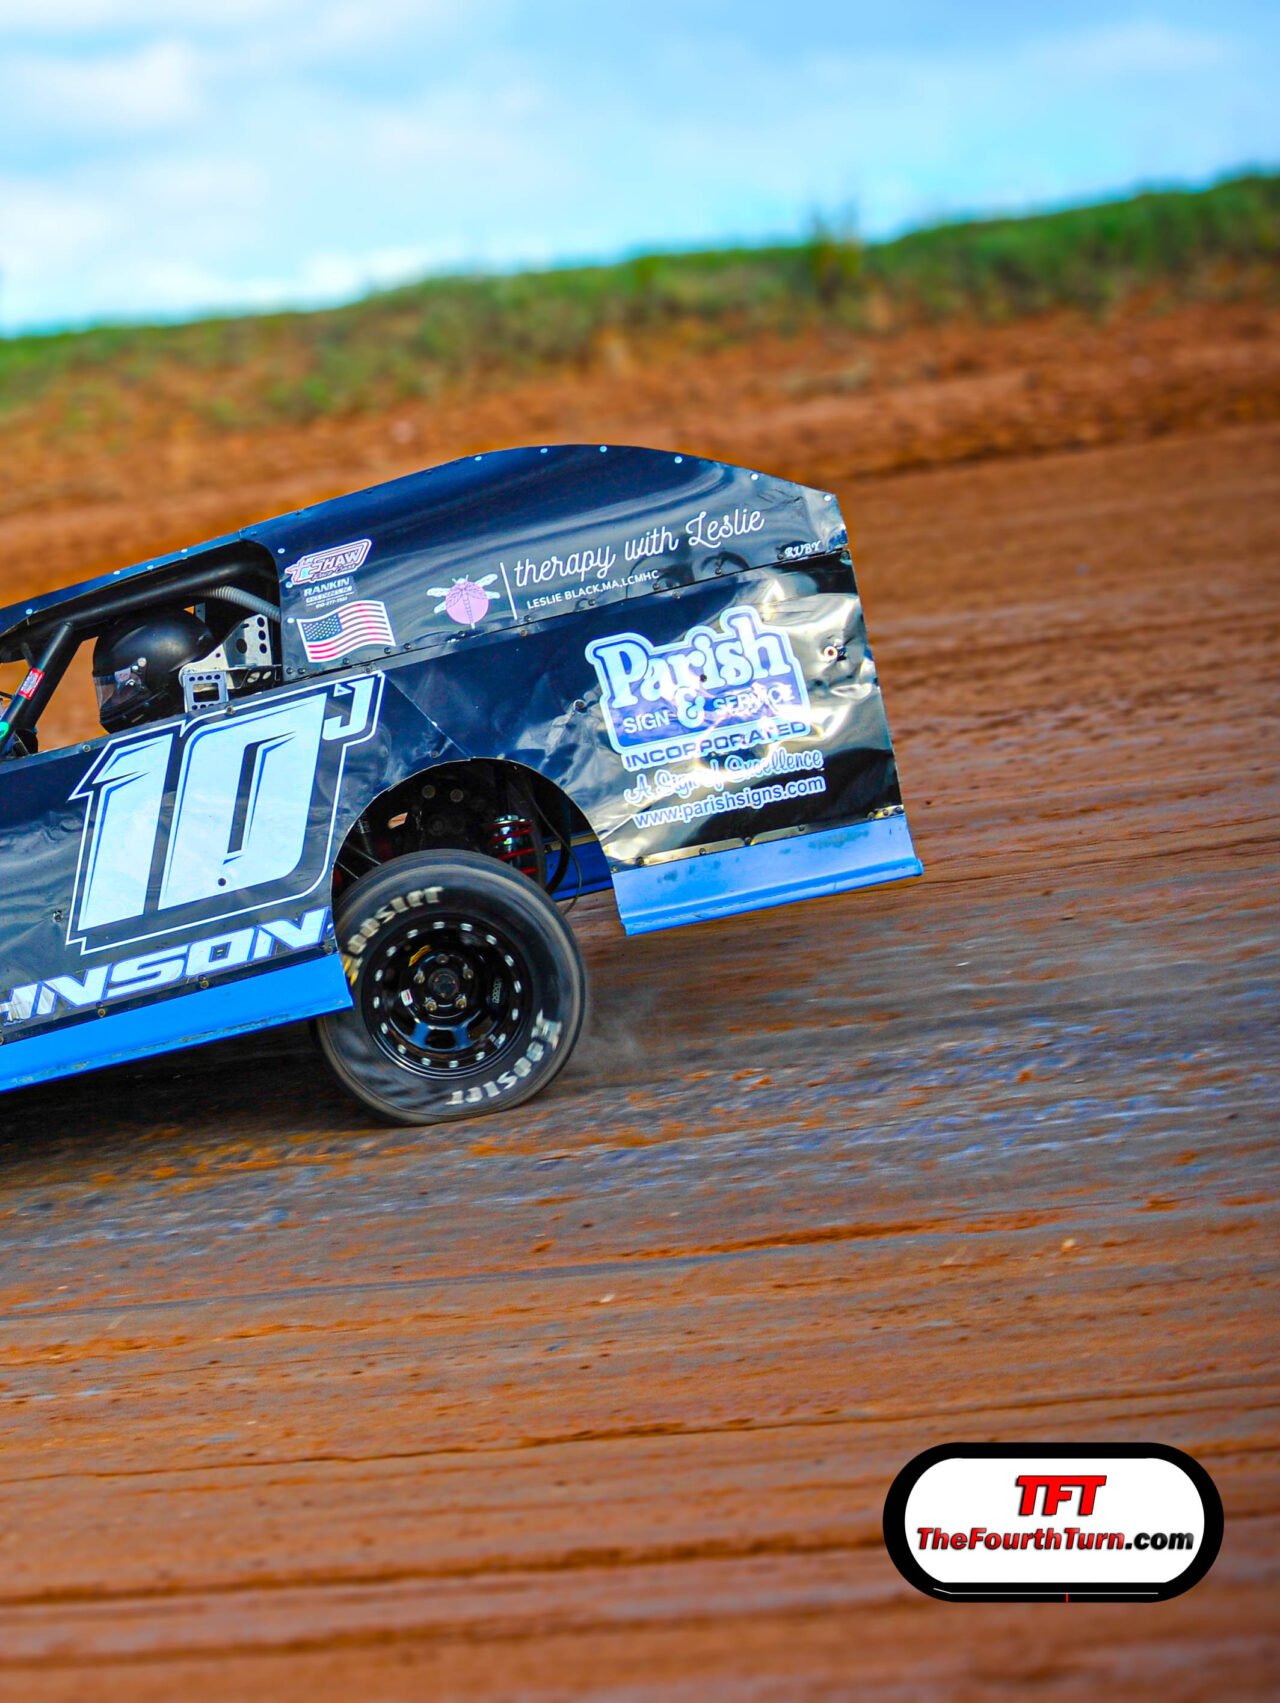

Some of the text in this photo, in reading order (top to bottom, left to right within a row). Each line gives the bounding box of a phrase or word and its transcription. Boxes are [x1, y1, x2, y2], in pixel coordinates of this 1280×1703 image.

[308, 548, 360, 577] SHAW
[513, 508, 765, 587] therapy with Leslie
[784, 540, 822, 558] RUBY
[304, 577, 350, 597] RANKIN
[526, 592, 561, 610] LESLIE
[595, 616, 792, 709] Parish
[623, 711, 671, 735] SIGN
[625, 720, 807, 769] INCORPORATED
[624, 773, 655, 806] A
[634, 775, 826, 830] www.parishsigns.com
